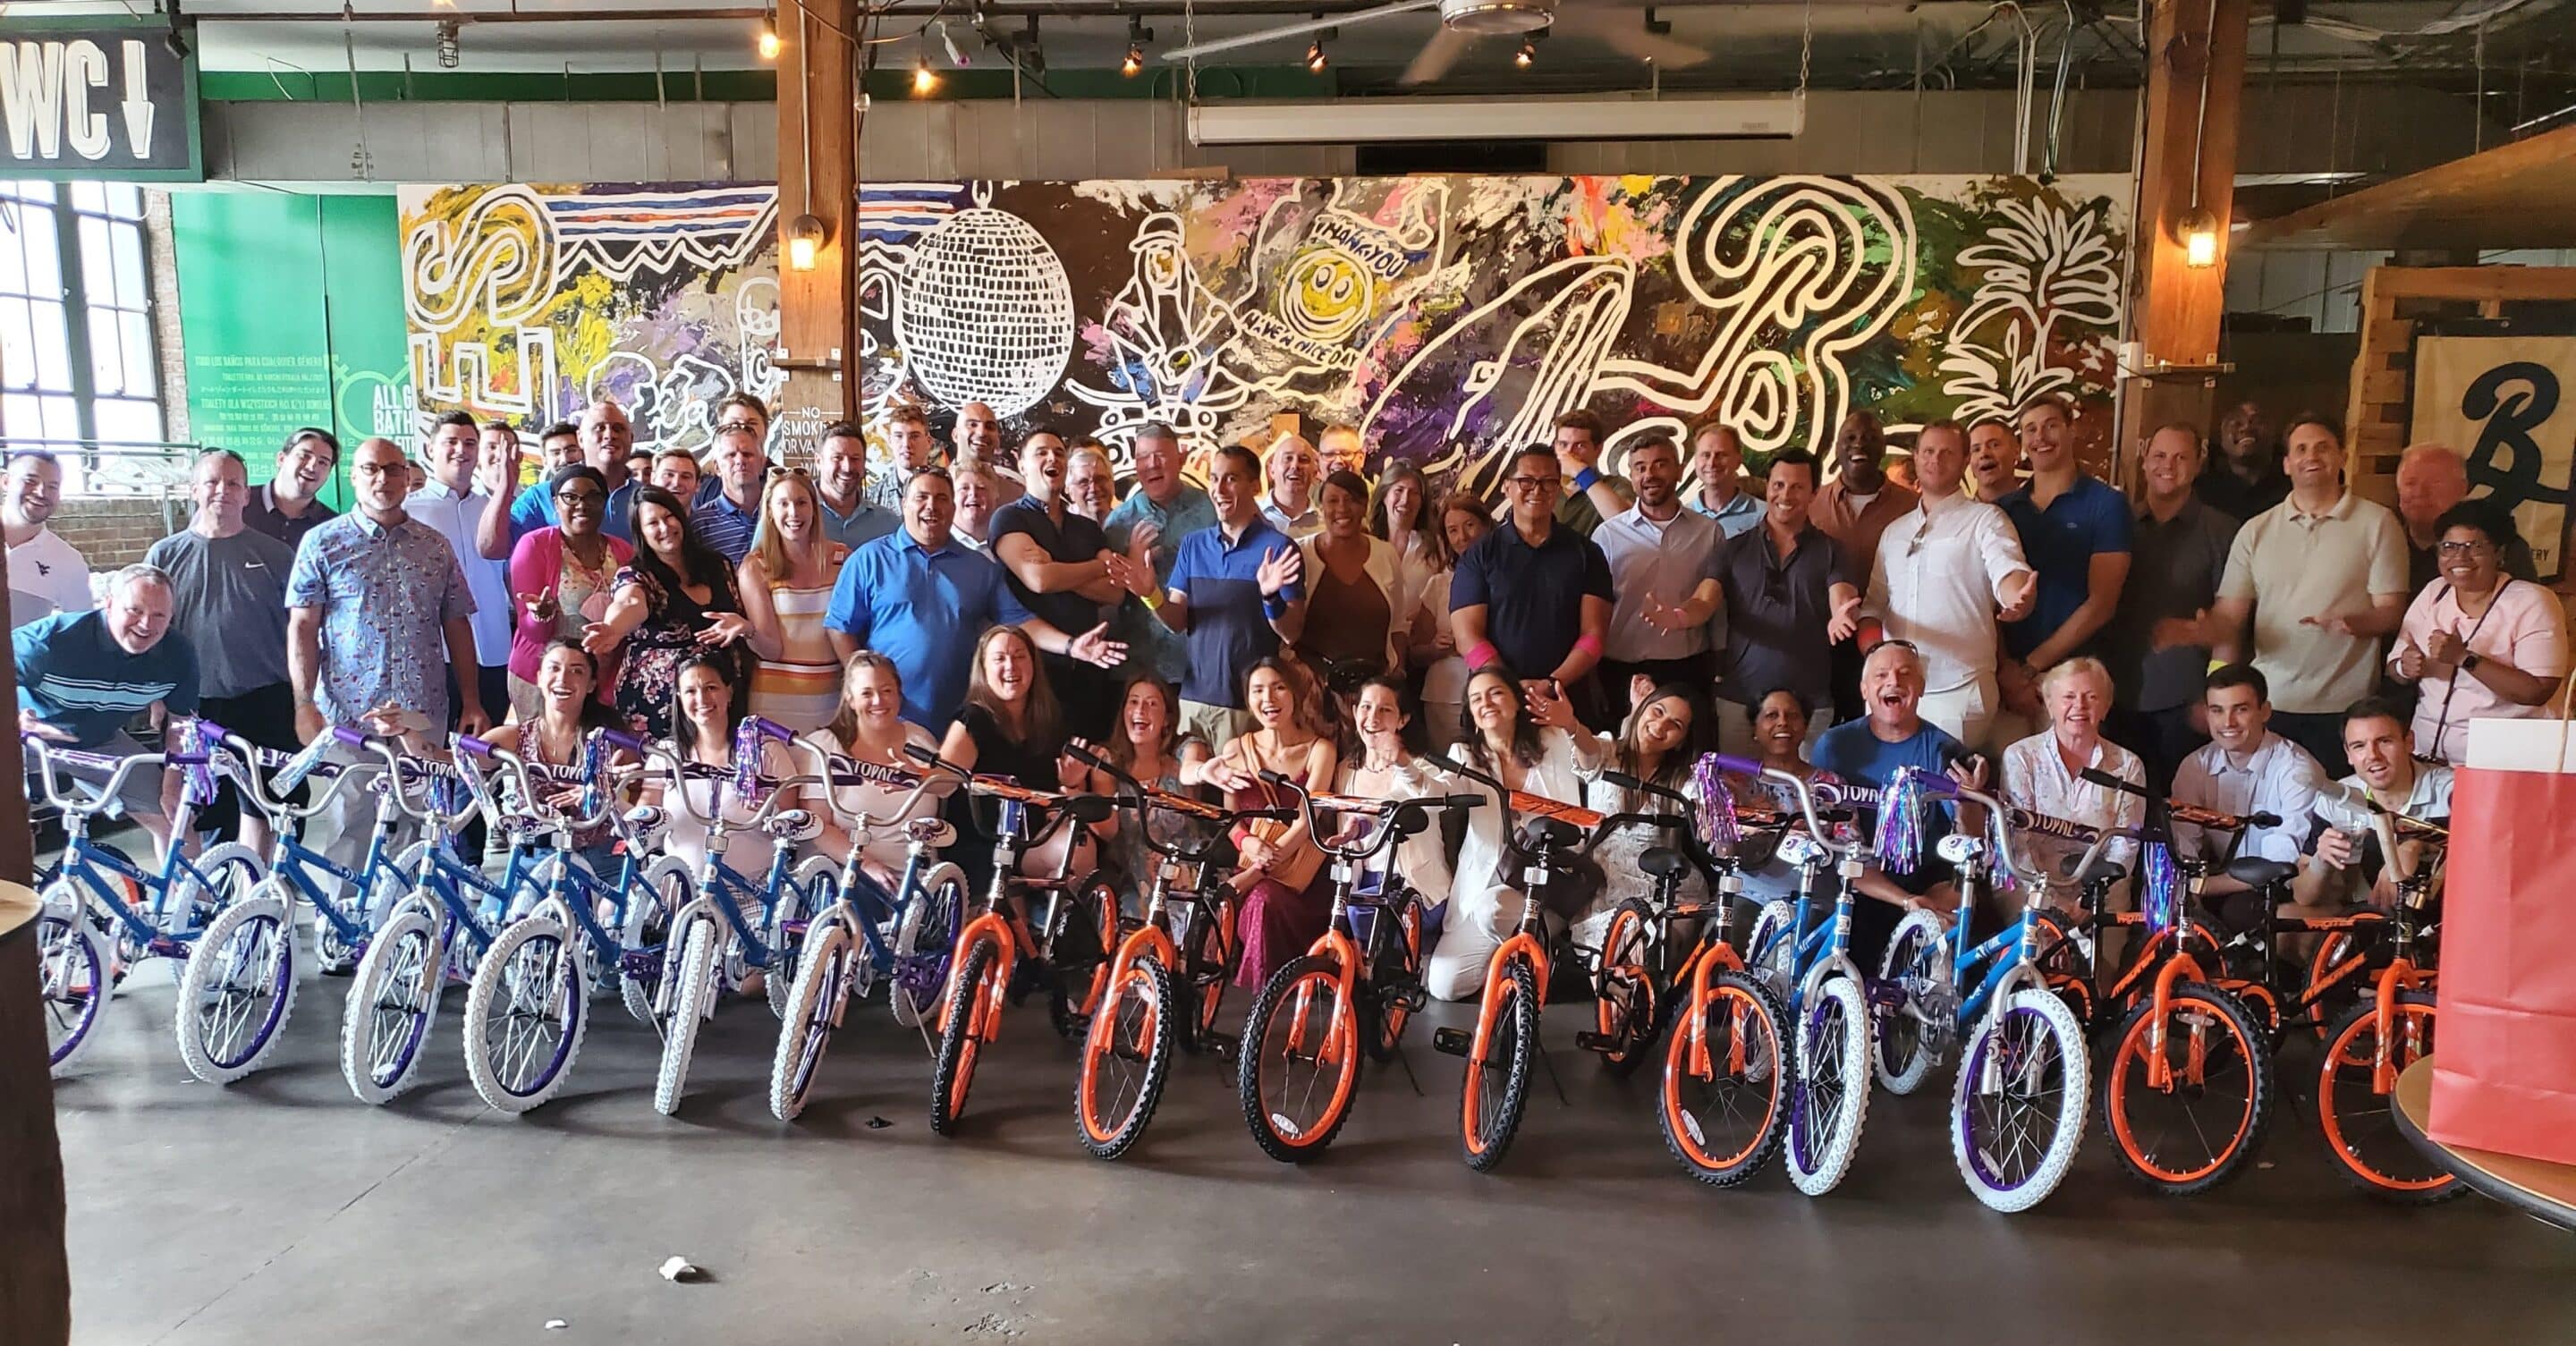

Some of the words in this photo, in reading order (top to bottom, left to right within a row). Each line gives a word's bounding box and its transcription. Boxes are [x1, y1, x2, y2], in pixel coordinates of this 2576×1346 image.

[0, 39, 111, 160] WC
[1364, 244, 1406, 276] YOU
[1242, 310, 1284, 339] HAVE
[1294, 340, 1333, 362] NICE
[1327, 350, 1358, 368] DAY
[373, 385, 402, 409] ALL
[801, 406, 820, 419] NO
[784, 438, 798, 453] OR
[798, 438, 815, 454] VA
[422, 759, 459, 779] TOPA
[551, 764, 586, 782] TOPA
[1841, 784, 1879, 803] TOPA
